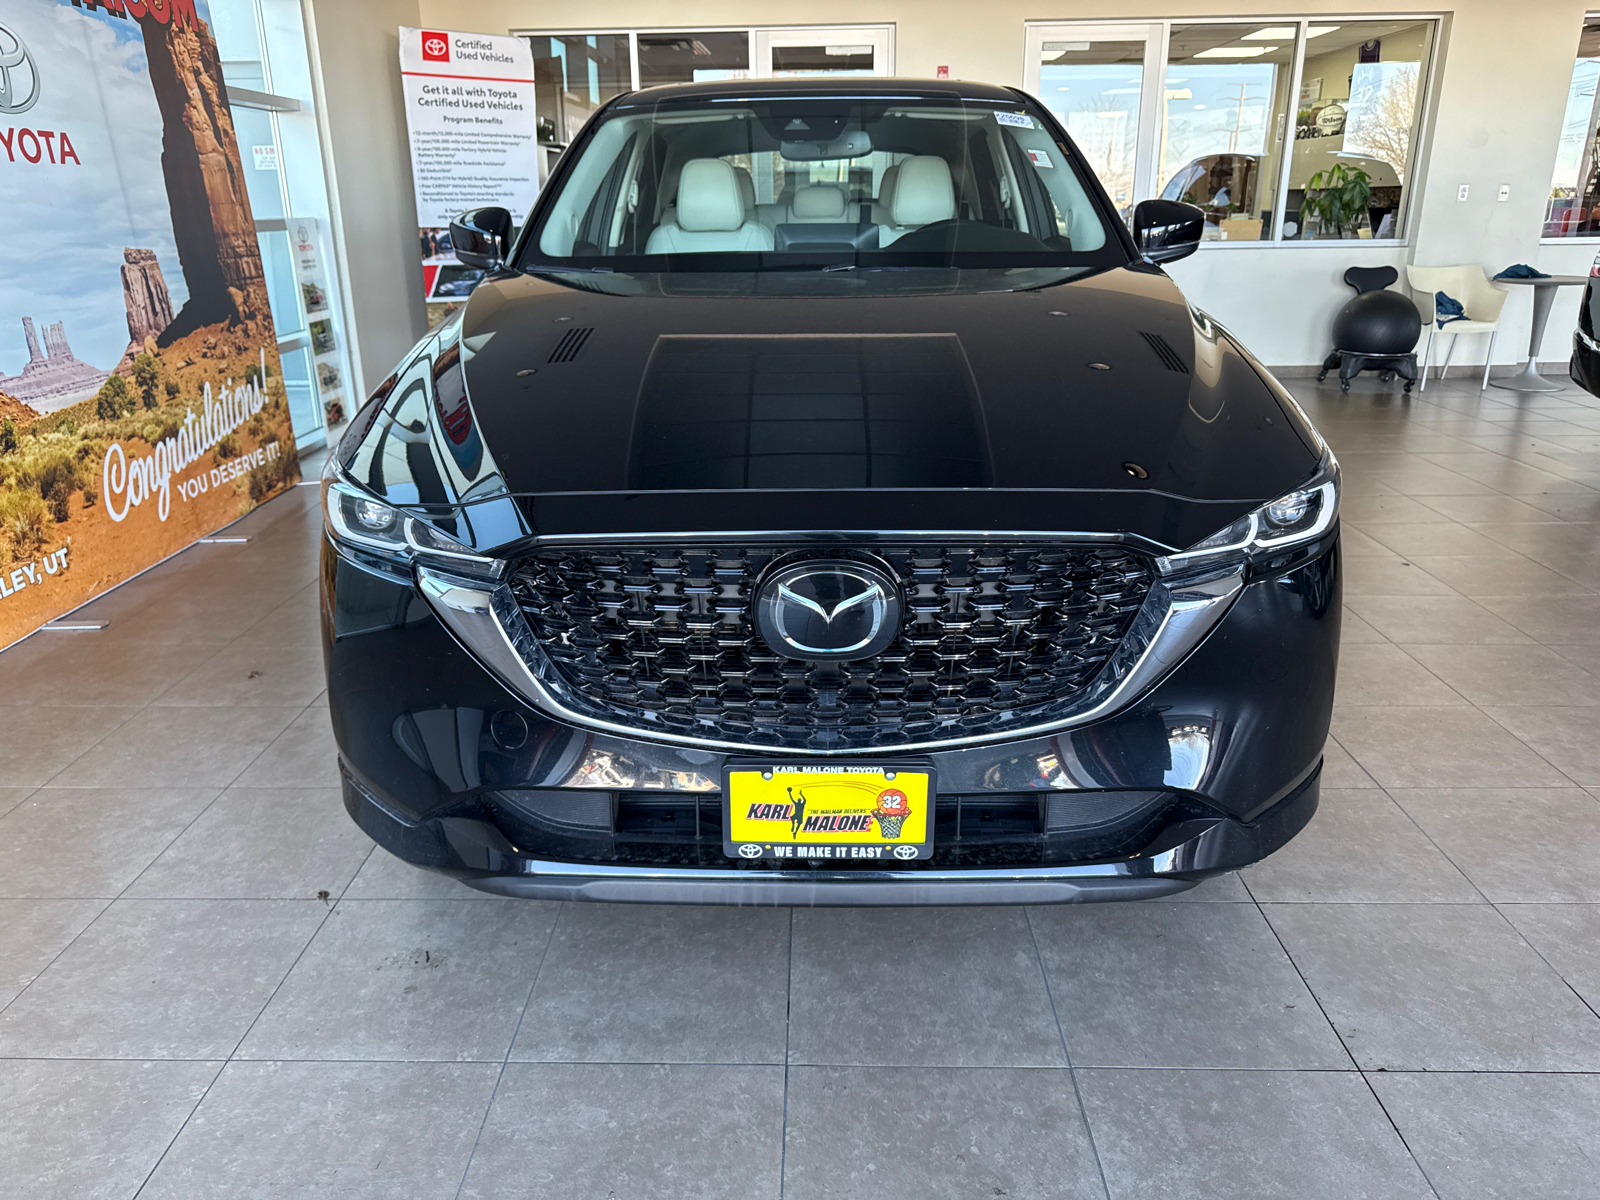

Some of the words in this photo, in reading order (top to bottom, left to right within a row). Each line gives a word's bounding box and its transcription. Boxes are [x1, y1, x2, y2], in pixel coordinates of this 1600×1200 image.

[454, 39, 492, 50] Certified
[456, 50, 478, 60] Used
[480, 52, 514, 64] Vehicles
[422, 85, 440, 94] Get
[442, 86, 449, 95] it
[452, 86, 463, 96] all
[465, 87, 486, 97] with
[488, 88, 518, 100] Toyota
[418, 97, 460, 108] Certified
[461, 99, 485, 109] Used
[486, 100, 523, 111] Vehicles
[443, 116, 474, 124] Program
[103, 347, 269, 522] Congratulations!
[177, 476, 208, 502] YOU
[210, 448, 266, 488] DESERVE
[266, 440, 281, 463] IT!
[42, 547, 68, 575] UT
[772, 766, 800, 774] KARL
[802, 766, 844, 774] MALONE
[882, 796, 901, 808] 32
[746, 803, 793, 820] KARL
[802, 814, 874, 832] MALONE
[774, 846, 793, 858] WE
[797, 846, 832, 858] MAKE
[836, 847, 848, 858] IT
[851, 847, 882, 858] EASY
